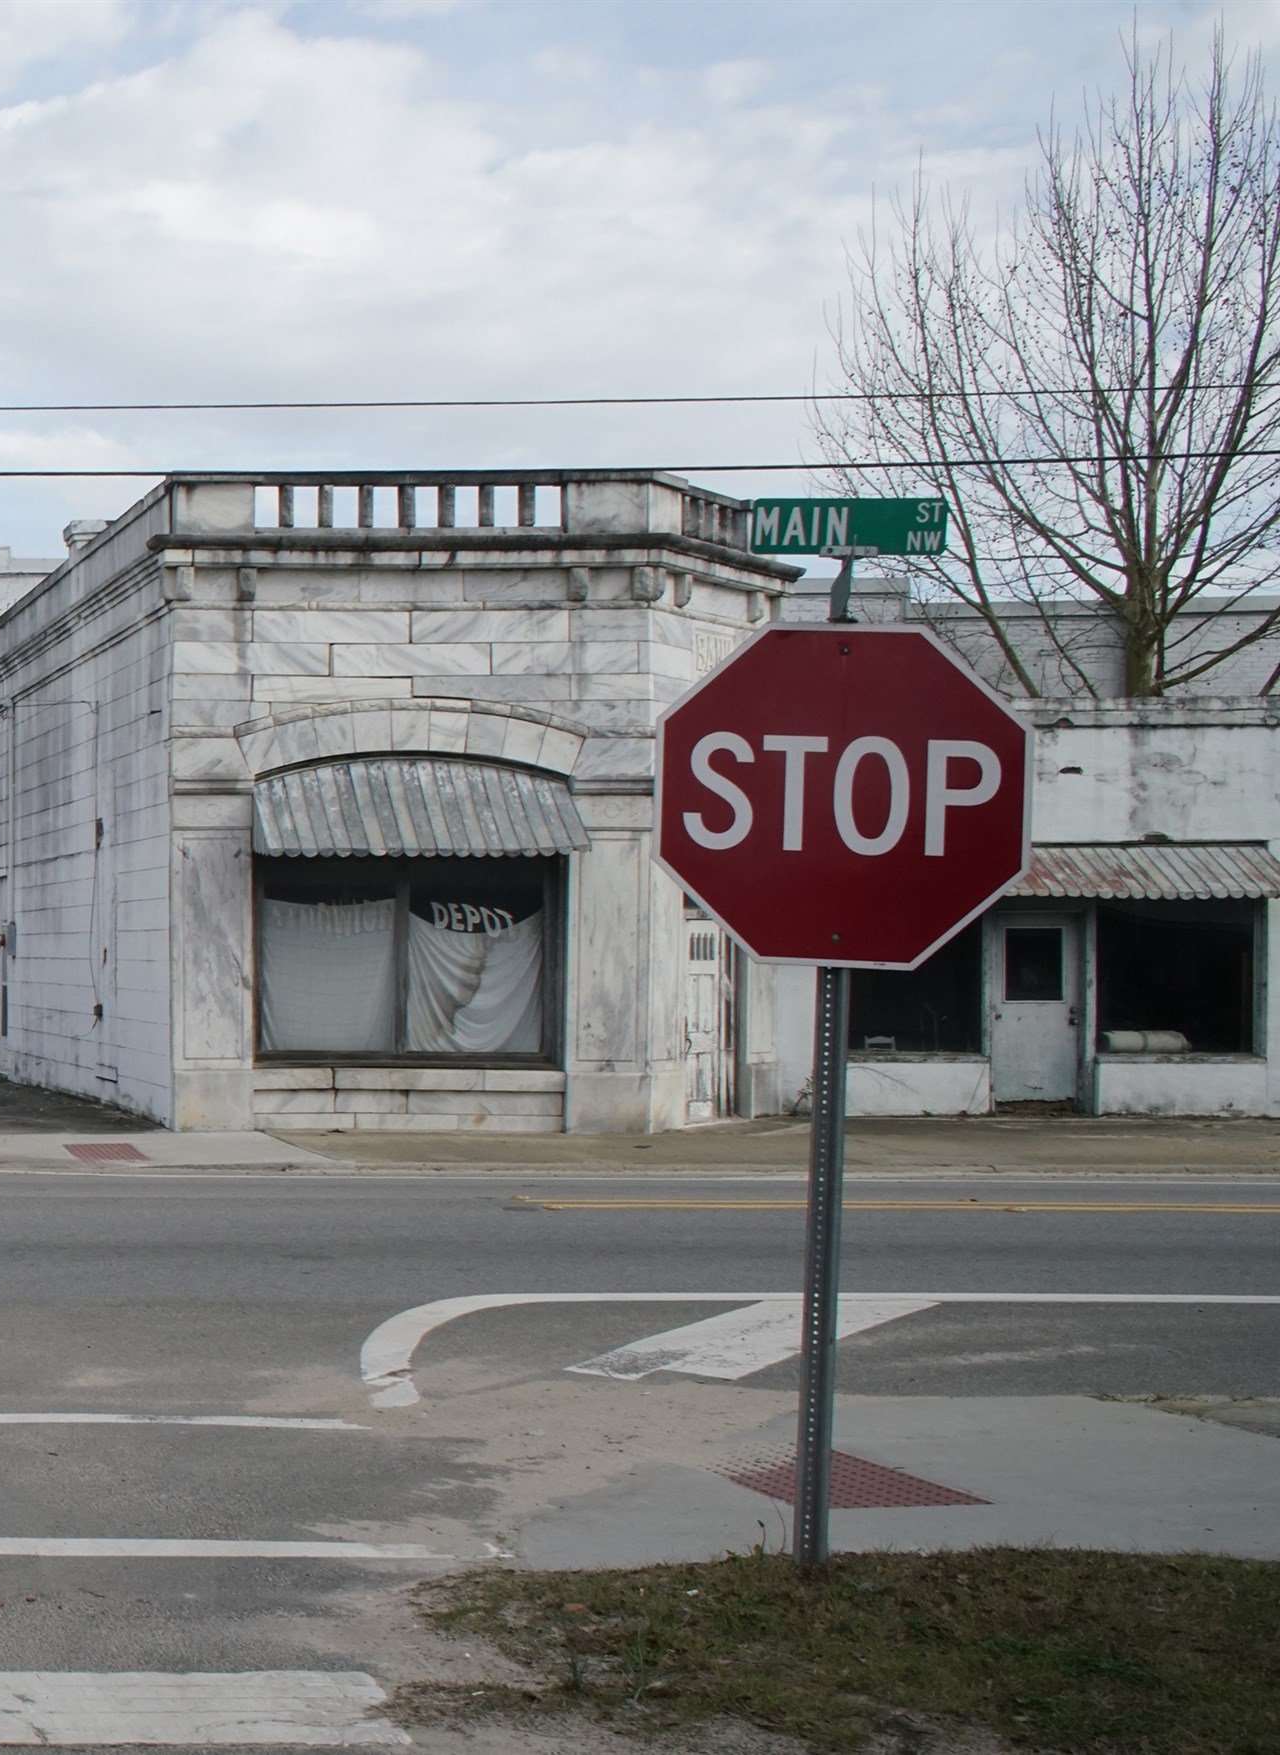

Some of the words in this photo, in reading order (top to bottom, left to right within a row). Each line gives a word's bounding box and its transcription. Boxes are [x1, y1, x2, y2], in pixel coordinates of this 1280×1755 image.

[754, 506, 850, 546] MAIN
[916, 501, 944, 524] ST
[906, 530, 942, 552] NW
[682, 731, 1002, 857] STOP
[430, 901, 513, 938] DEPOT
